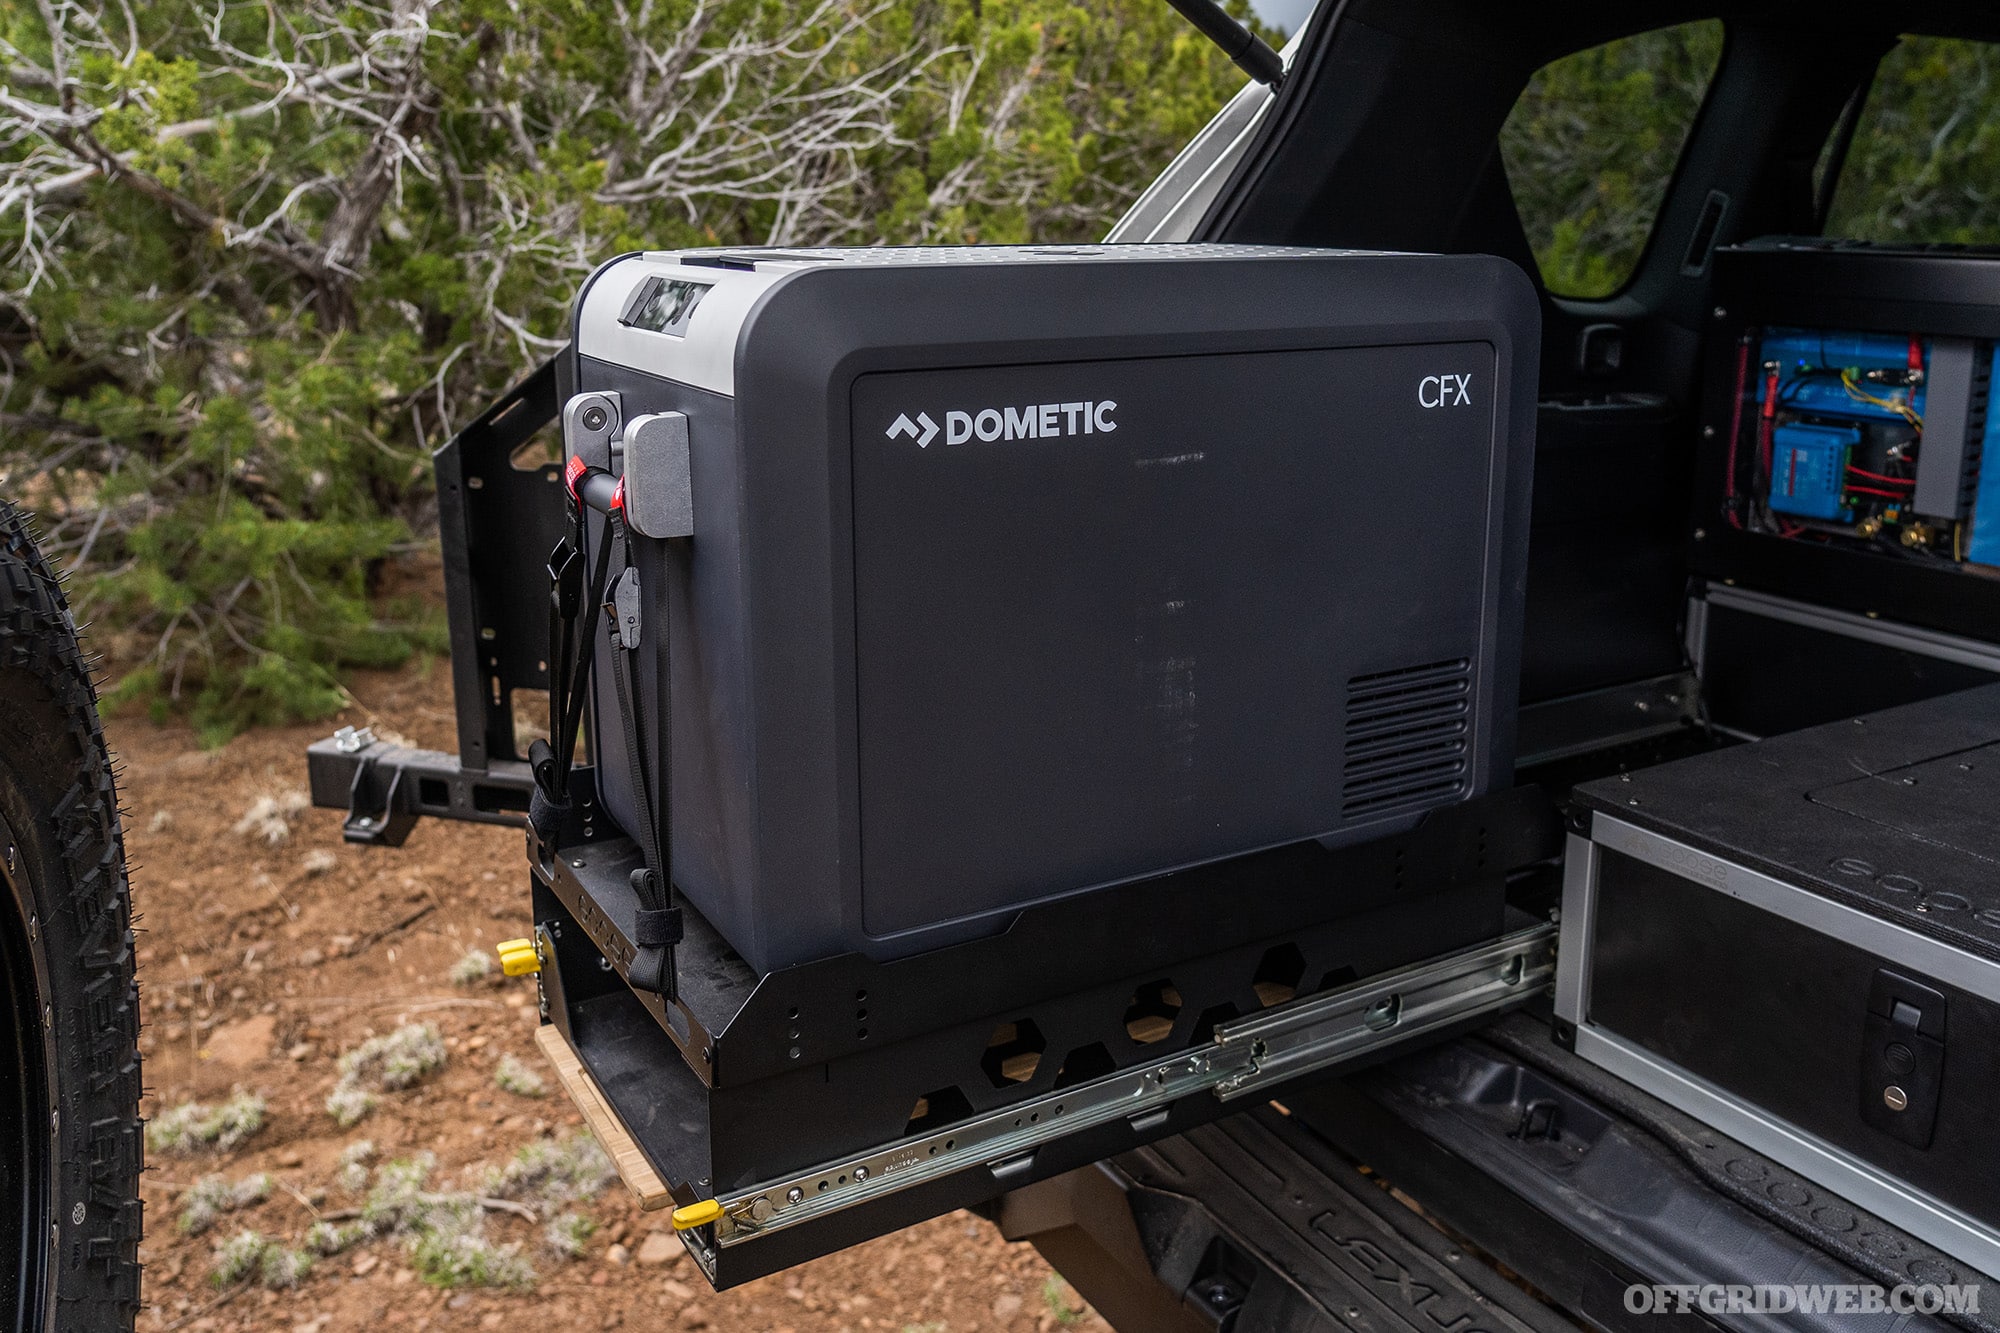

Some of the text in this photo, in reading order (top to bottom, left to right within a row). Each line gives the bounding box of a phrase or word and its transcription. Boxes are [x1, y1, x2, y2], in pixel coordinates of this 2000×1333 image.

[1418, 373, 1472, 409] CFX
[945, 400, 1118, 446] DOMETIC
[1308, 1210, 1487, 1333] LEXU
